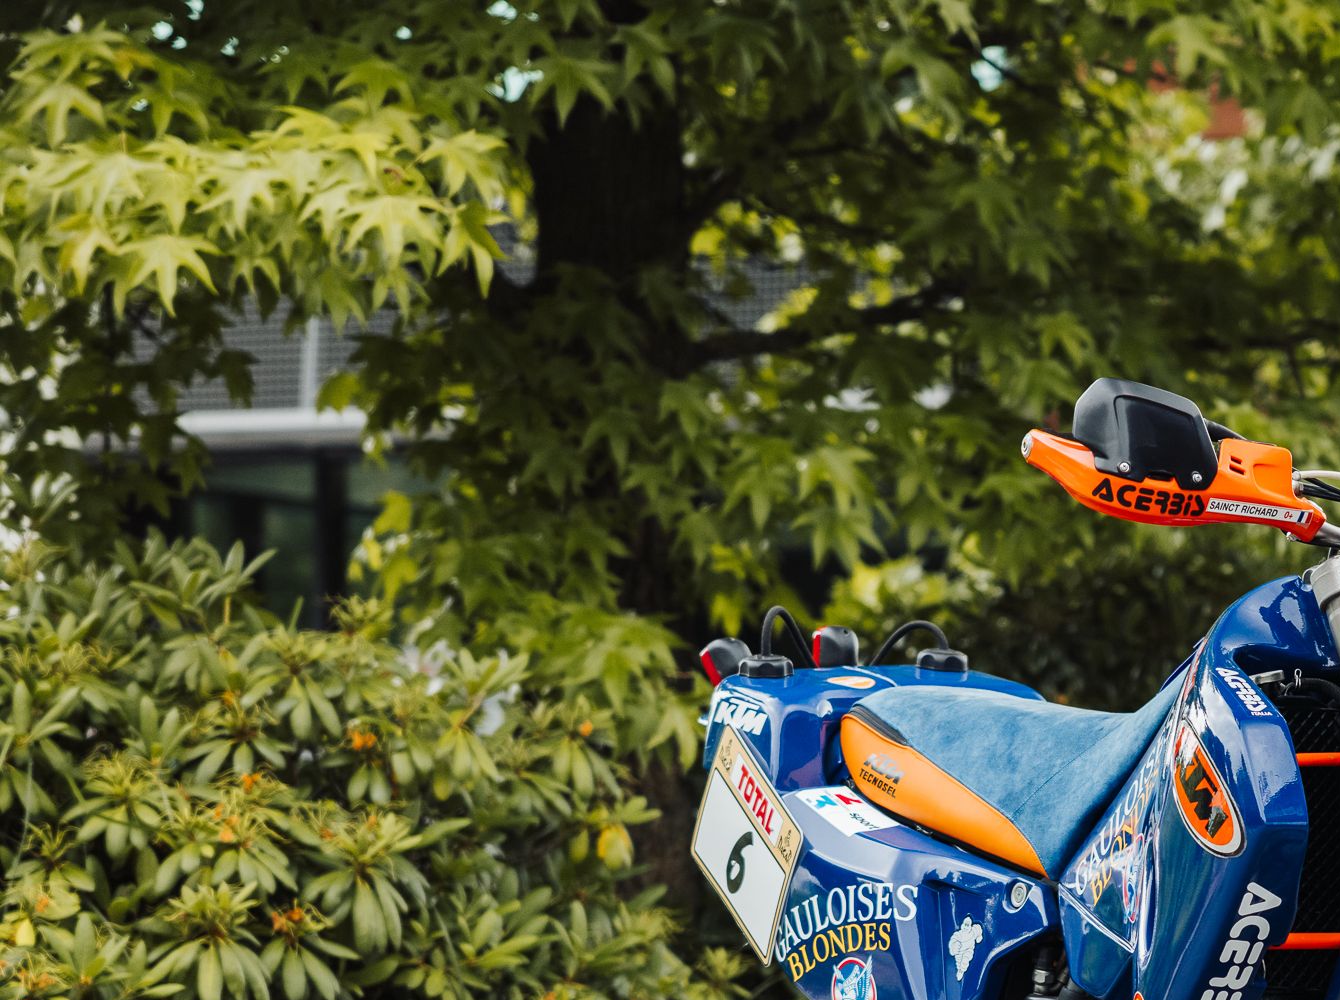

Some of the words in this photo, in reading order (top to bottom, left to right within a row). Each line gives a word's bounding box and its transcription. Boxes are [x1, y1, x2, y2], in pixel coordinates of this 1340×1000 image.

[1091, 477, 1205, 517] ACERBIS
[1209, 501, 1240, 512] SAINCT
[1240, 504, 1279, 517] RICHARD
[1215, 667, 1268, 712] ACERBIS
[714, 697, 768, 736] KTM
[737, 764, 774, 836] TOTAL
[859, 768, 897, 799] TECNOSEL
[1074, 724, 1171, 896] GAULOIS
[725, 830, 754, 894] 6
[774, 882, 919, 963] GAULOISES
[787, 922, 891, 983] BLONDES
